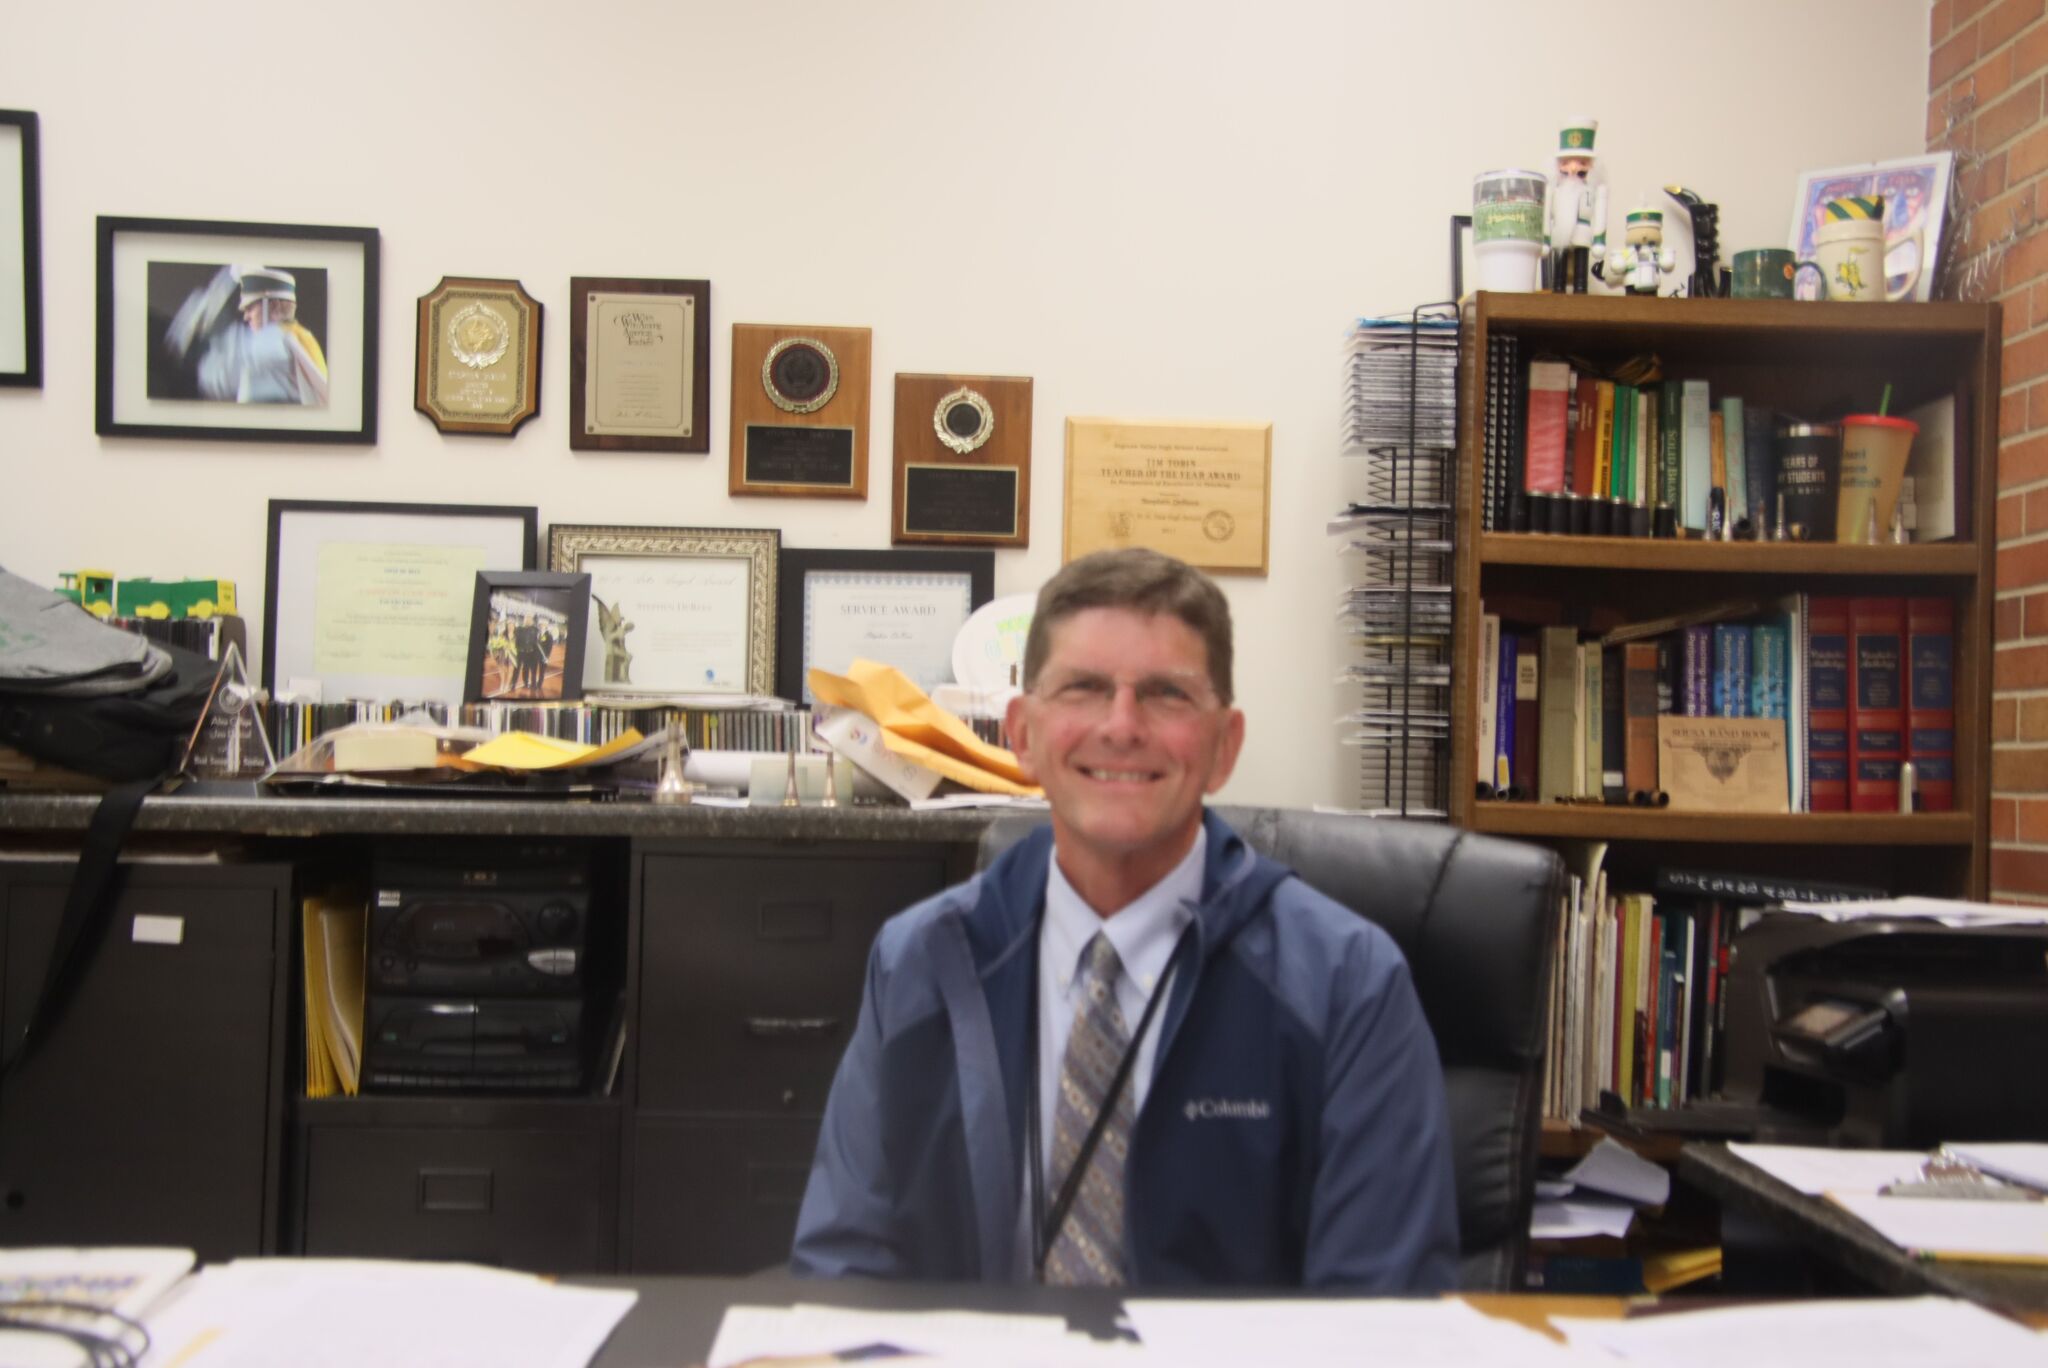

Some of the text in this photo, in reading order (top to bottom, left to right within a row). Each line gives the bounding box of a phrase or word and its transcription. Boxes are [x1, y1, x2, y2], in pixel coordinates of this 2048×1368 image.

[1101, 469, 1241, 481] TEACHER OF THE YEAR AWARD
[1787, 470, 1826, 484] STUDENTS
[841, 604, 937, 617] SERVICE AWARD
[1687, 632, 1696, 691] Performance
[1698, 632, 1708, 676] Teaching
[1723, 633, 1732, 691] Performance
